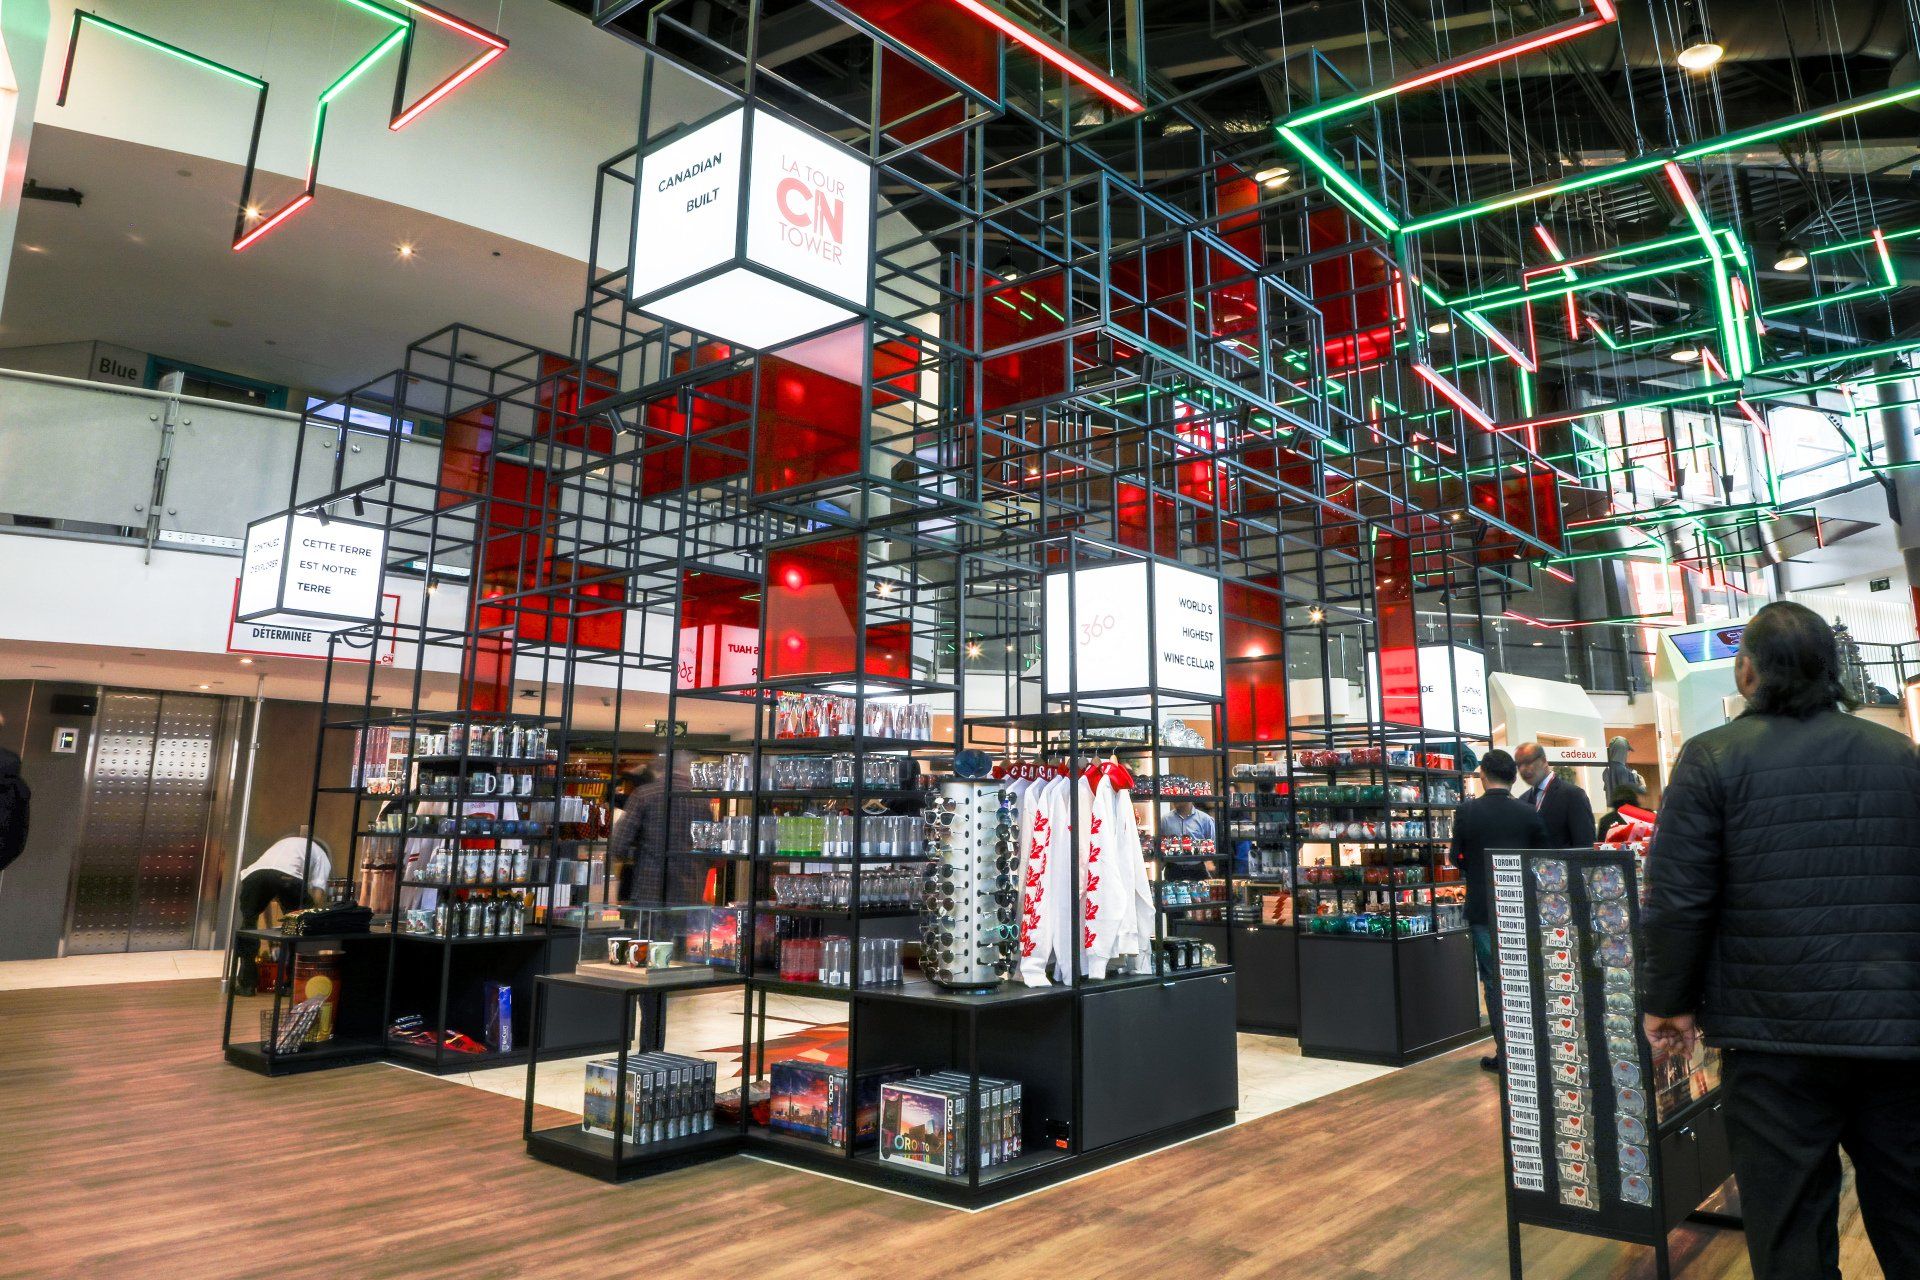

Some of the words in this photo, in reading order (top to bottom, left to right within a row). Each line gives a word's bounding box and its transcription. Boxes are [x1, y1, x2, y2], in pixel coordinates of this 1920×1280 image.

[658, 152, 722, 192] CANADIAN
[781, 154, 800, 177] LA
[805, 165, 845, 198] TOUR
[686, 187, 720, 213] BUILT
[776, 177, 844, 245] CN
[778, 221, 842, 265] TOWER
[99, 357, 138, 381] Blue
[302, 538, 336, 551] CETTE
[339, 544, 372, 557] TERRE
[299, 560, 318, 570] EST
[321, 563, 357, 576] NOTRE
[297, 581, 331, 595] TERRE
[1080, 614, 1115, 646] 360
[1182, 626, 1213, 643] HIGHEST
[1163, 651, 1185, 666] WINE
[1186, 656, 1215, 671] CELLAR
[1560, 749, 1597, 759] cadeaux
[1494, 858, 1520, 867] TORONTO
[1495, 874, 1521, 883] TORONTO
[1496, 890, 1523, 899] TORONTO
[1498, 905, 1524, 914] TORONTO
[1499, 920, 1525, 930] TORONTO
[1500, 936, 1526, 945] TORONTO
[1501, 952, 1527, 962] TORONTO
[1502, 968, 1528, 978] TORONTO
[1503, 983, 1529, 993] TORONTO
[1504, 999, 1530, 1009] TORONTO
[1505, 1014, 1531, 1025] TORONTO
[1506, 1030, 1534, 1040] TORONTO
[1507, 1046, 1534, 1056] TORONTO
[1508, 1061, 1535, 1073] TORONTO
[1509, 1078, 1536, 1088] TORONTO
[1510, 1093, 1537, 1104] TORONTO
[1512, 1109, 1539, 1120] TORONTO
[1512, 1125, 1539, 1137] TORONTO
[1513, 1143, 1540, 1154] TORONTO
[1515, 1160, 1542, 1171] TORONTO
[1515, 1176, 1542, 1187] TORONTO
